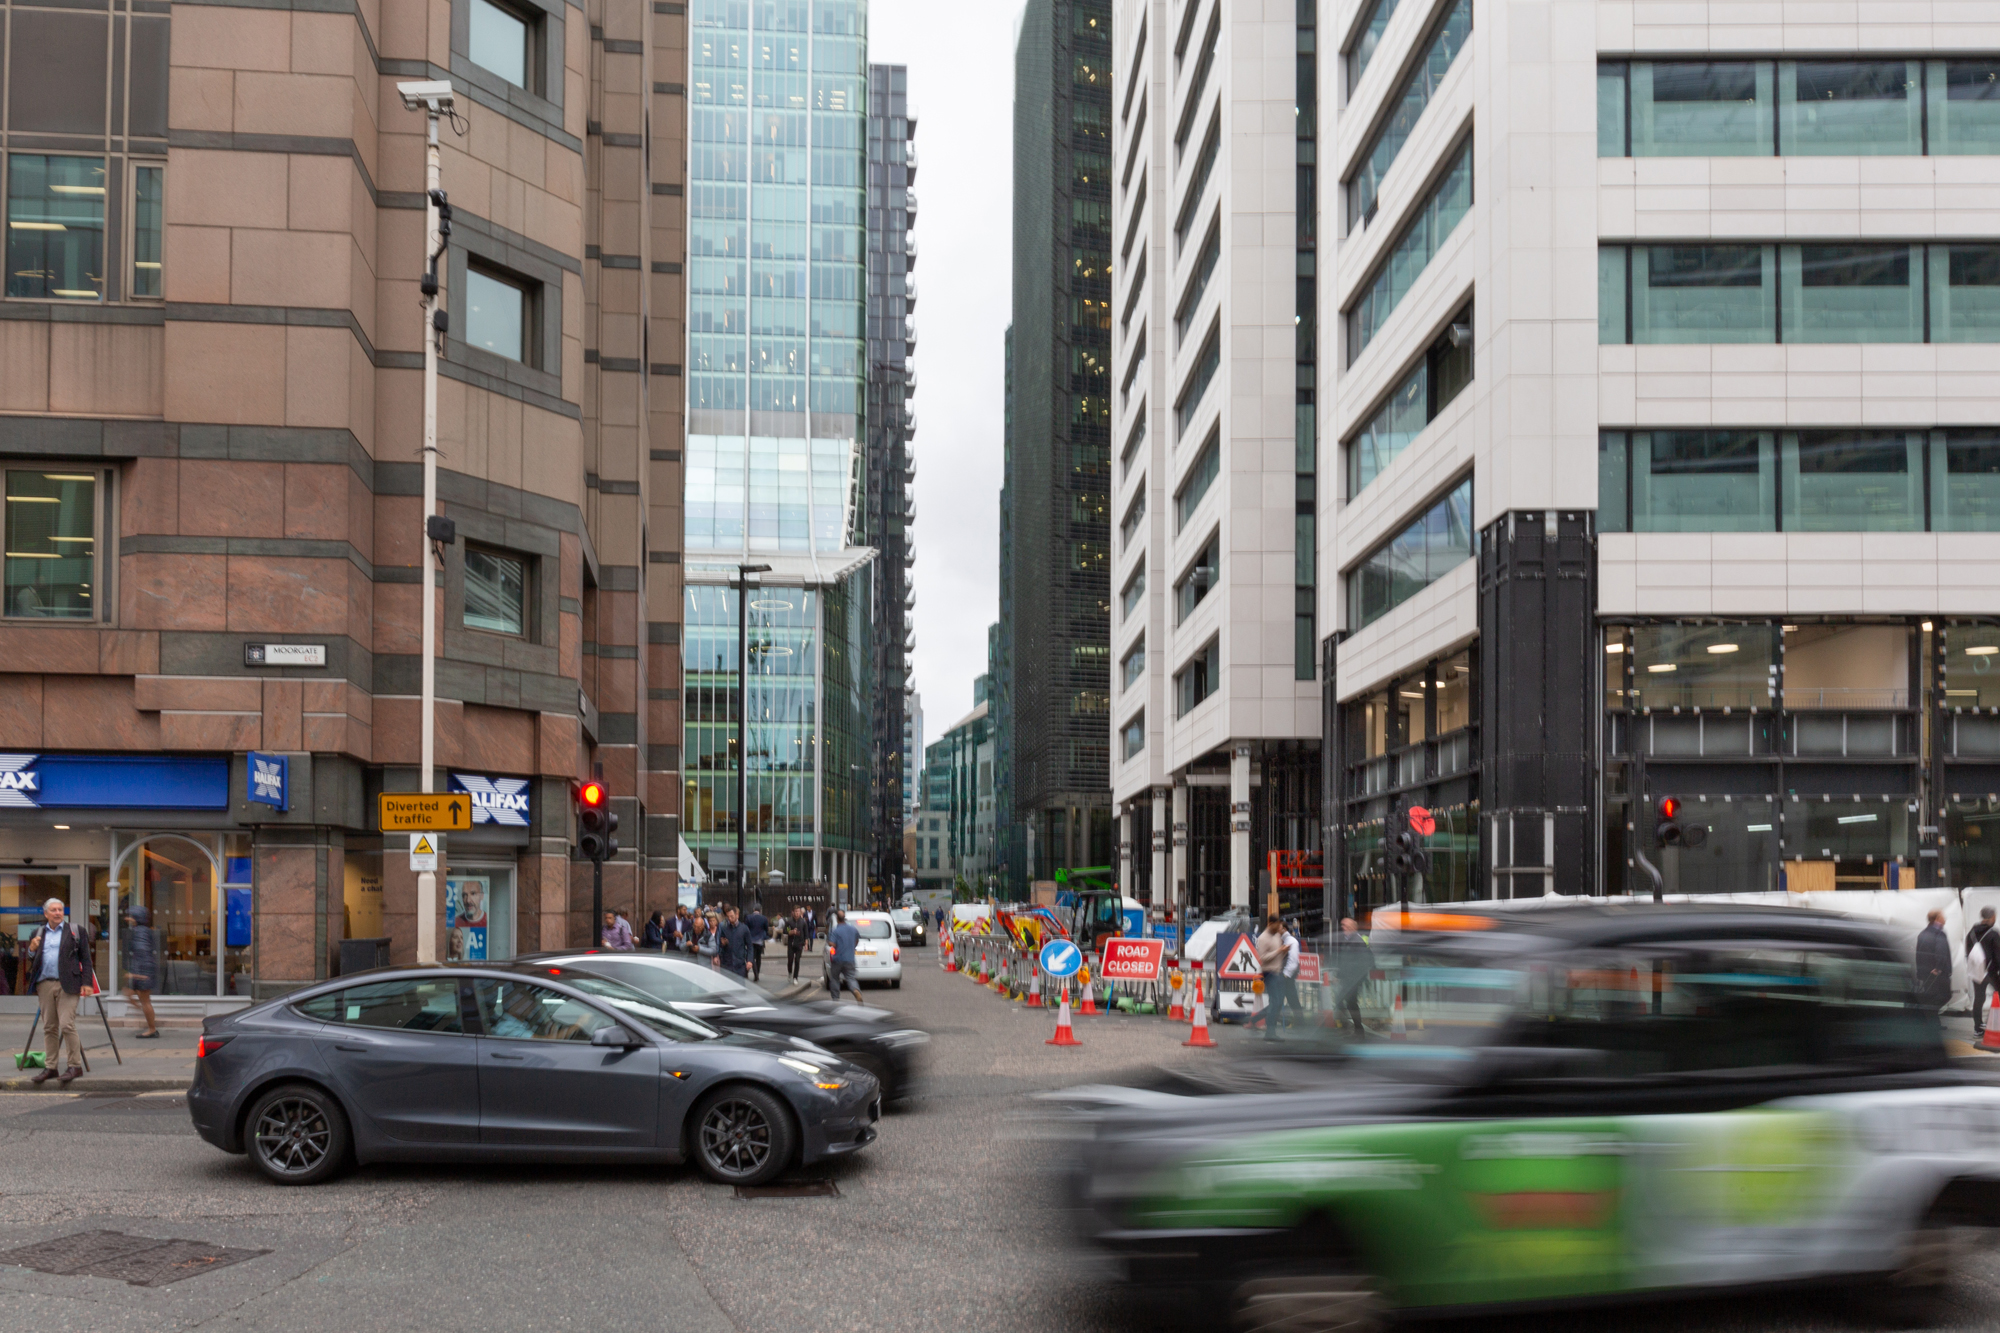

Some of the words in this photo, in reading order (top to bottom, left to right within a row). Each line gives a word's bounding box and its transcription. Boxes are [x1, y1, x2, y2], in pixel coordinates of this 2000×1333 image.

[273, 646, 318, 654] MOORGATE
[254, 770, 281, 789] HALIFAX
[387, 801, 439, 811] Diverted
[453, 790, 529, 811] ALIFAX
[394, 814, 432, 824] traffic
[787, 895, 825, 903] CITYPOINT
[466, 932, 483, 950] A:
[1117, 945, 1149, 958] ROAD
[1108, 960, 1154, 974] CLOSED
